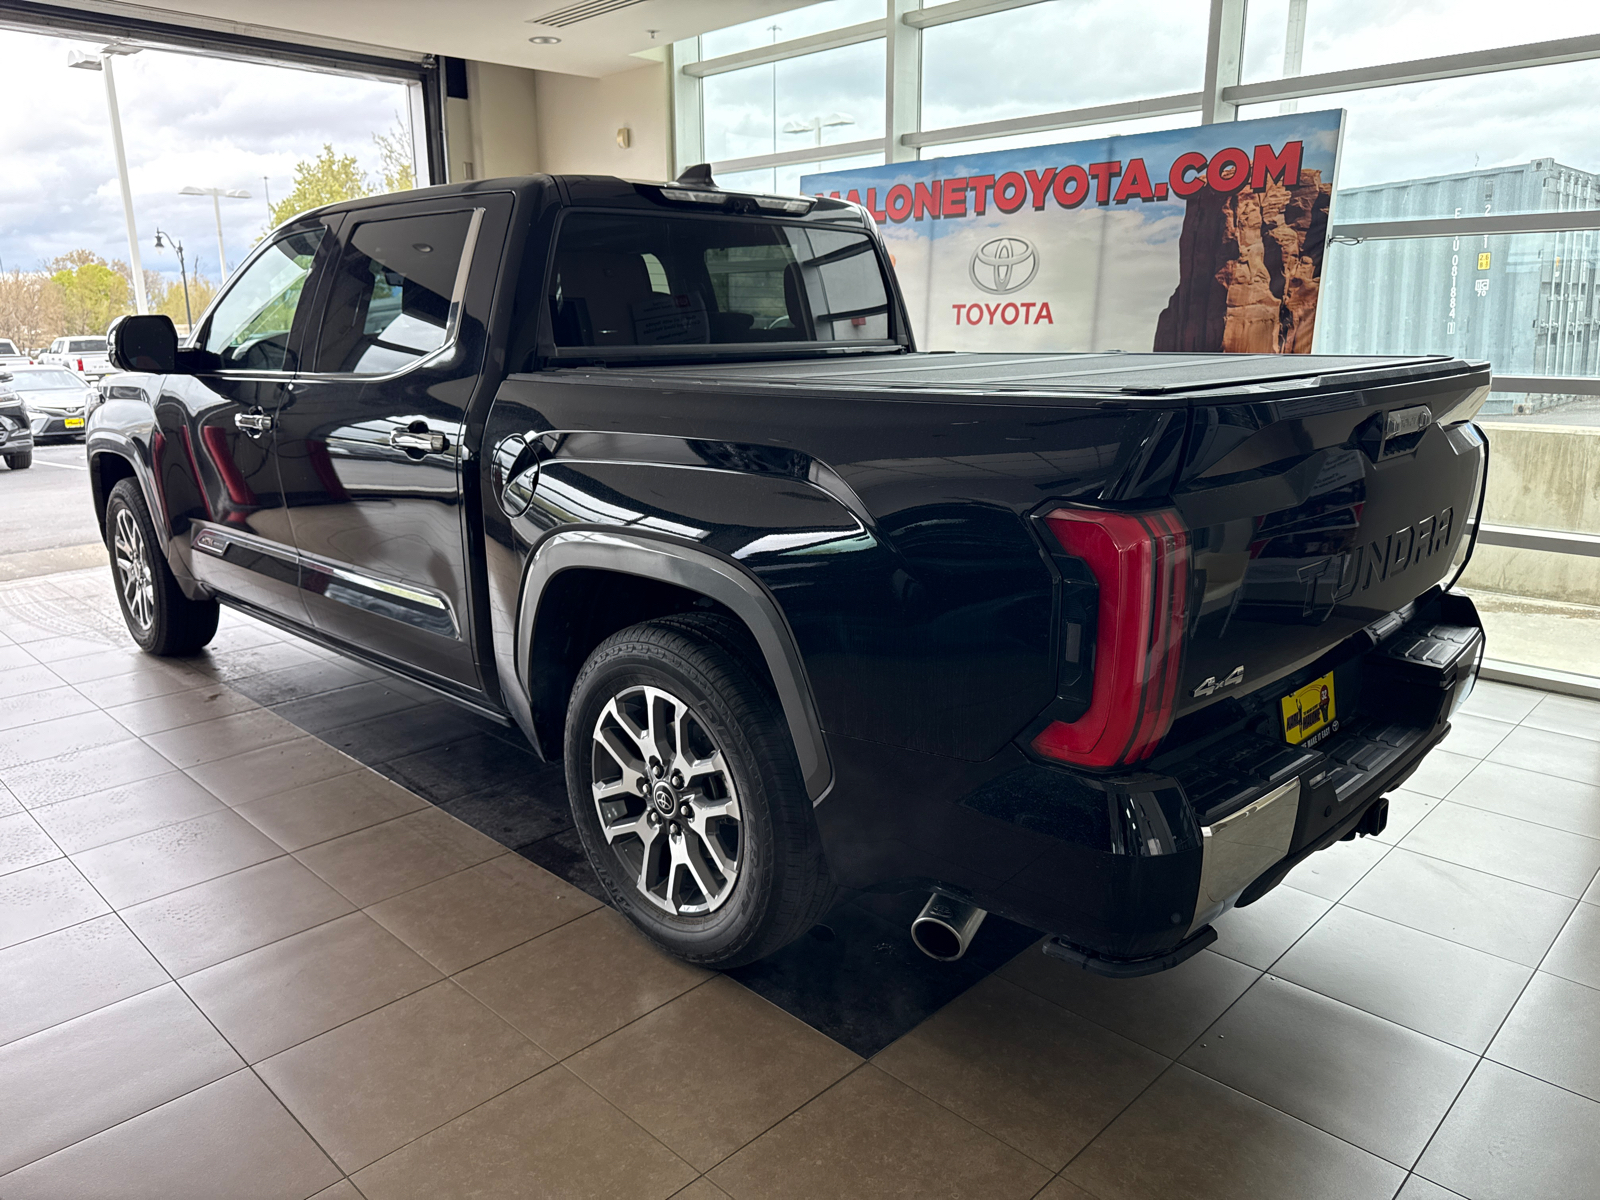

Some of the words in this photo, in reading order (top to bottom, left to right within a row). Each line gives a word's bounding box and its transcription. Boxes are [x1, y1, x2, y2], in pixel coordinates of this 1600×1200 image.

[814, 141, 1303, 224] LONETOYOTA.COM
[952, 302, 1054, 326] TOYOTA
[1297, 506, 1454, 618] TUNDRA
[1322, 690, 1327, 700] 32
[1307, 735, 1318, 748] MAKE
[1322, 727, 1330, 739] EASY
